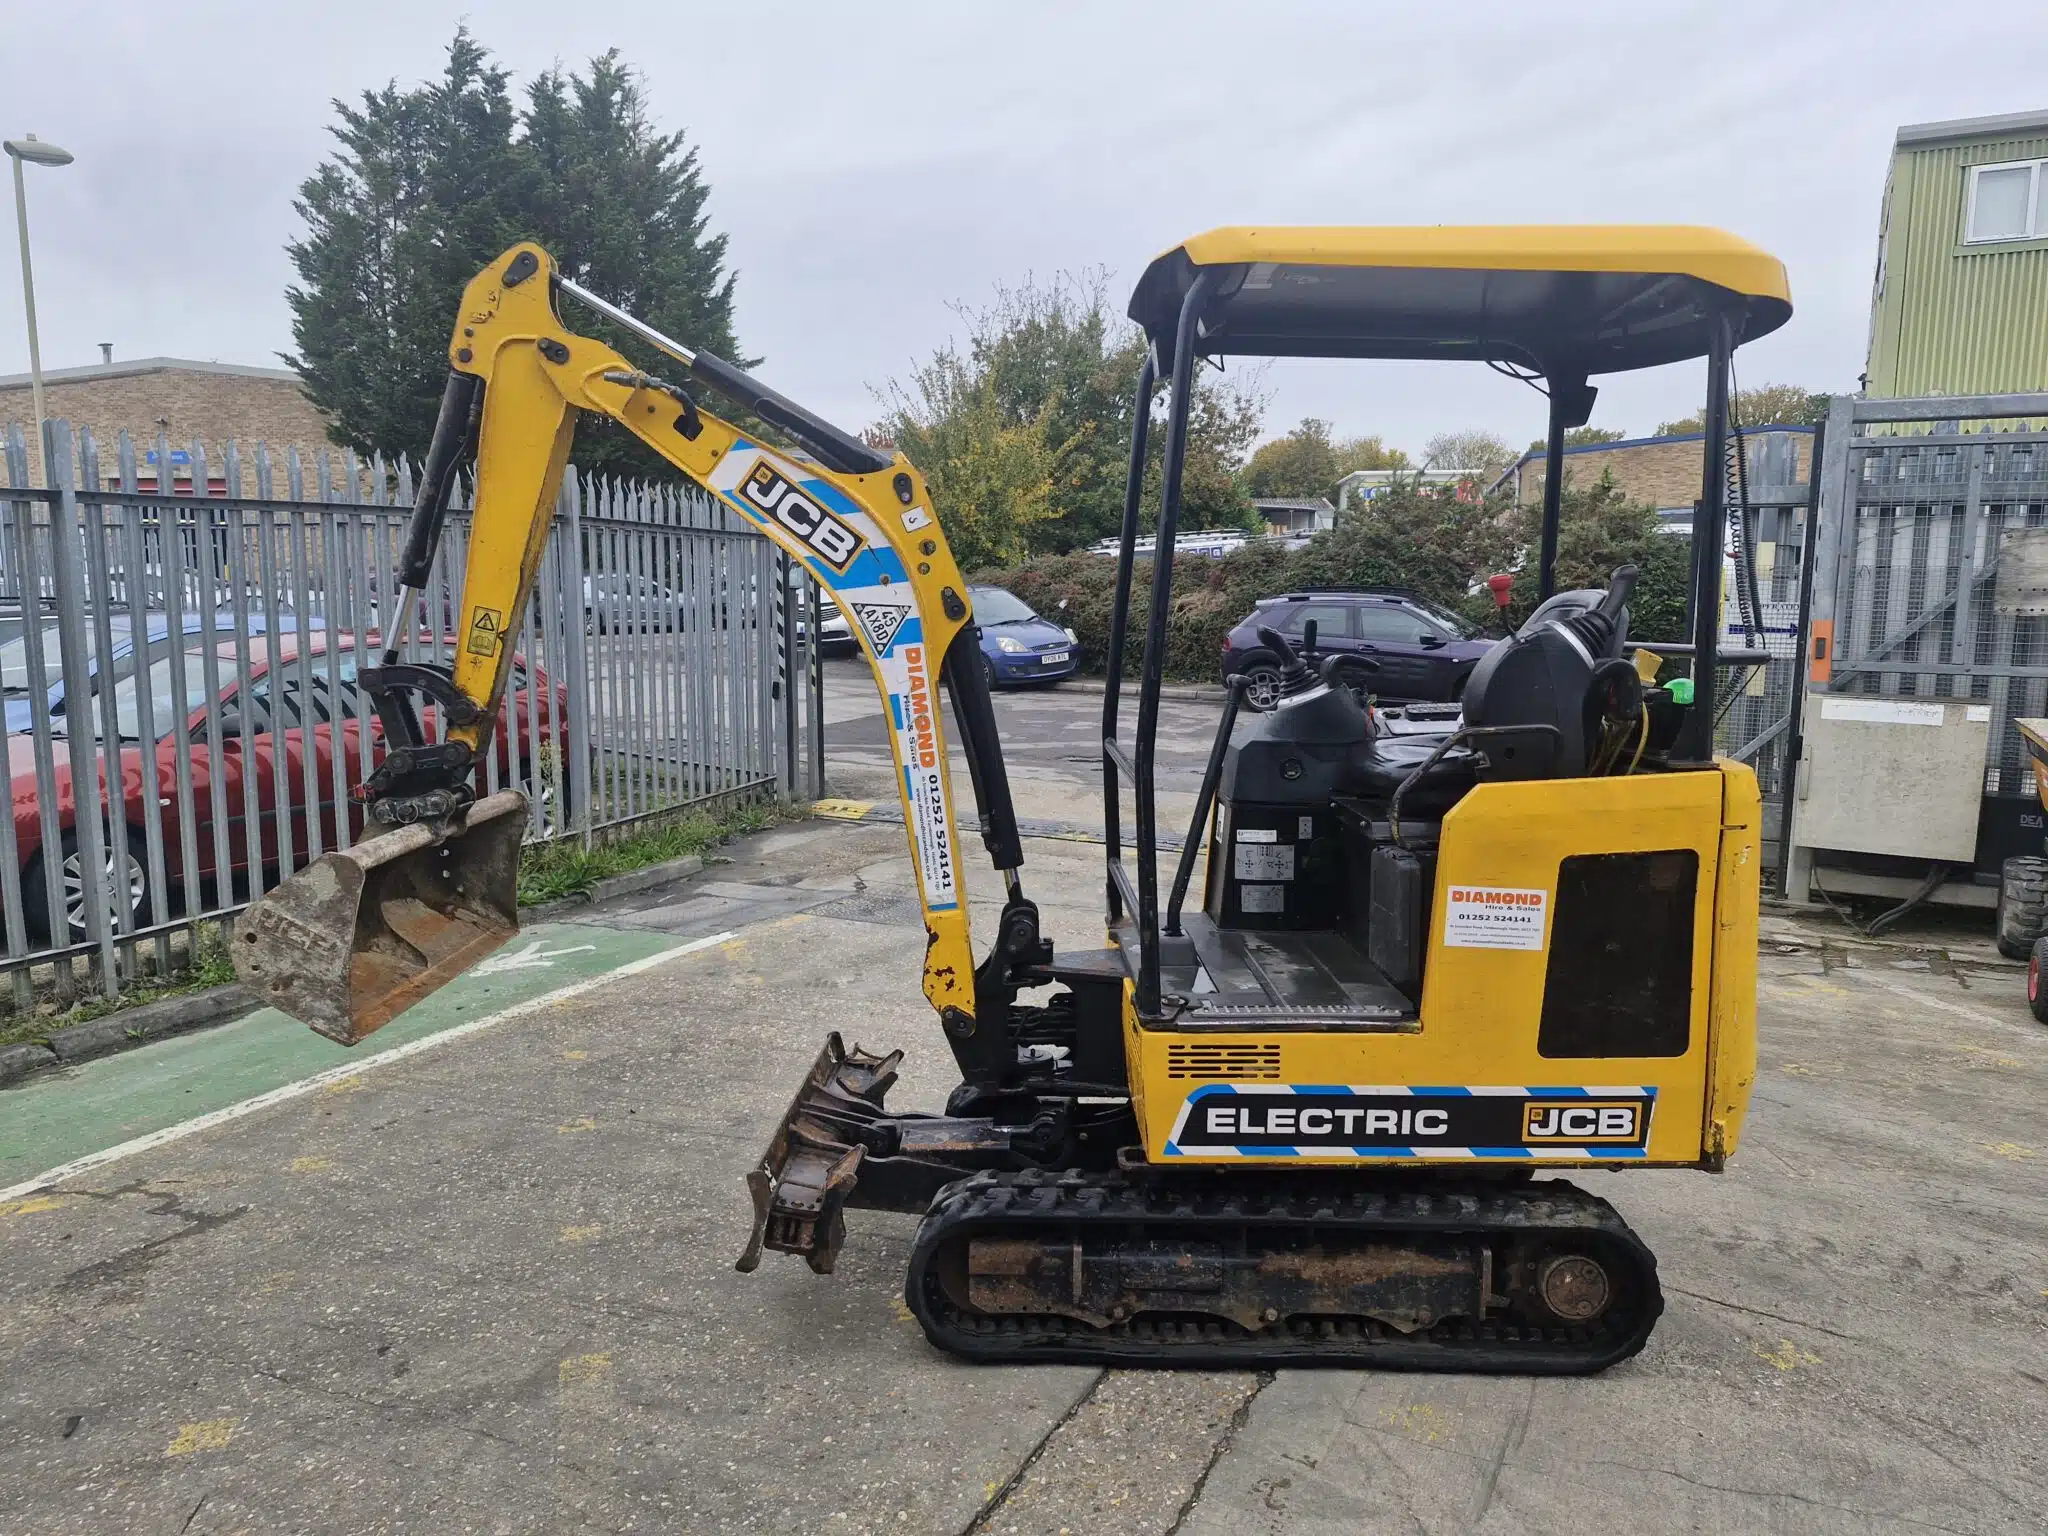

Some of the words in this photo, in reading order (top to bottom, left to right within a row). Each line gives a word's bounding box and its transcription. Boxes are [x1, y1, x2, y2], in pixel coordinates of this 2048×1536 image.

[746, 480, 856, 563] JCB
[881, 611, 897, 627] 45
[905, 647, 935, 768] DIAMOND
[928, 774, 943, 825] 01252
[936, 830, 952, 890] 524141
[1451, 890, 1542, 906] DIAMOND
[1458, 913, 1491, 922] 01252
[1493, 915, 1532, 923] 524141
[1206, 1108, 1449, 1136] ELECTRIC
[1529, 1108, 1633, 1136] JCB
